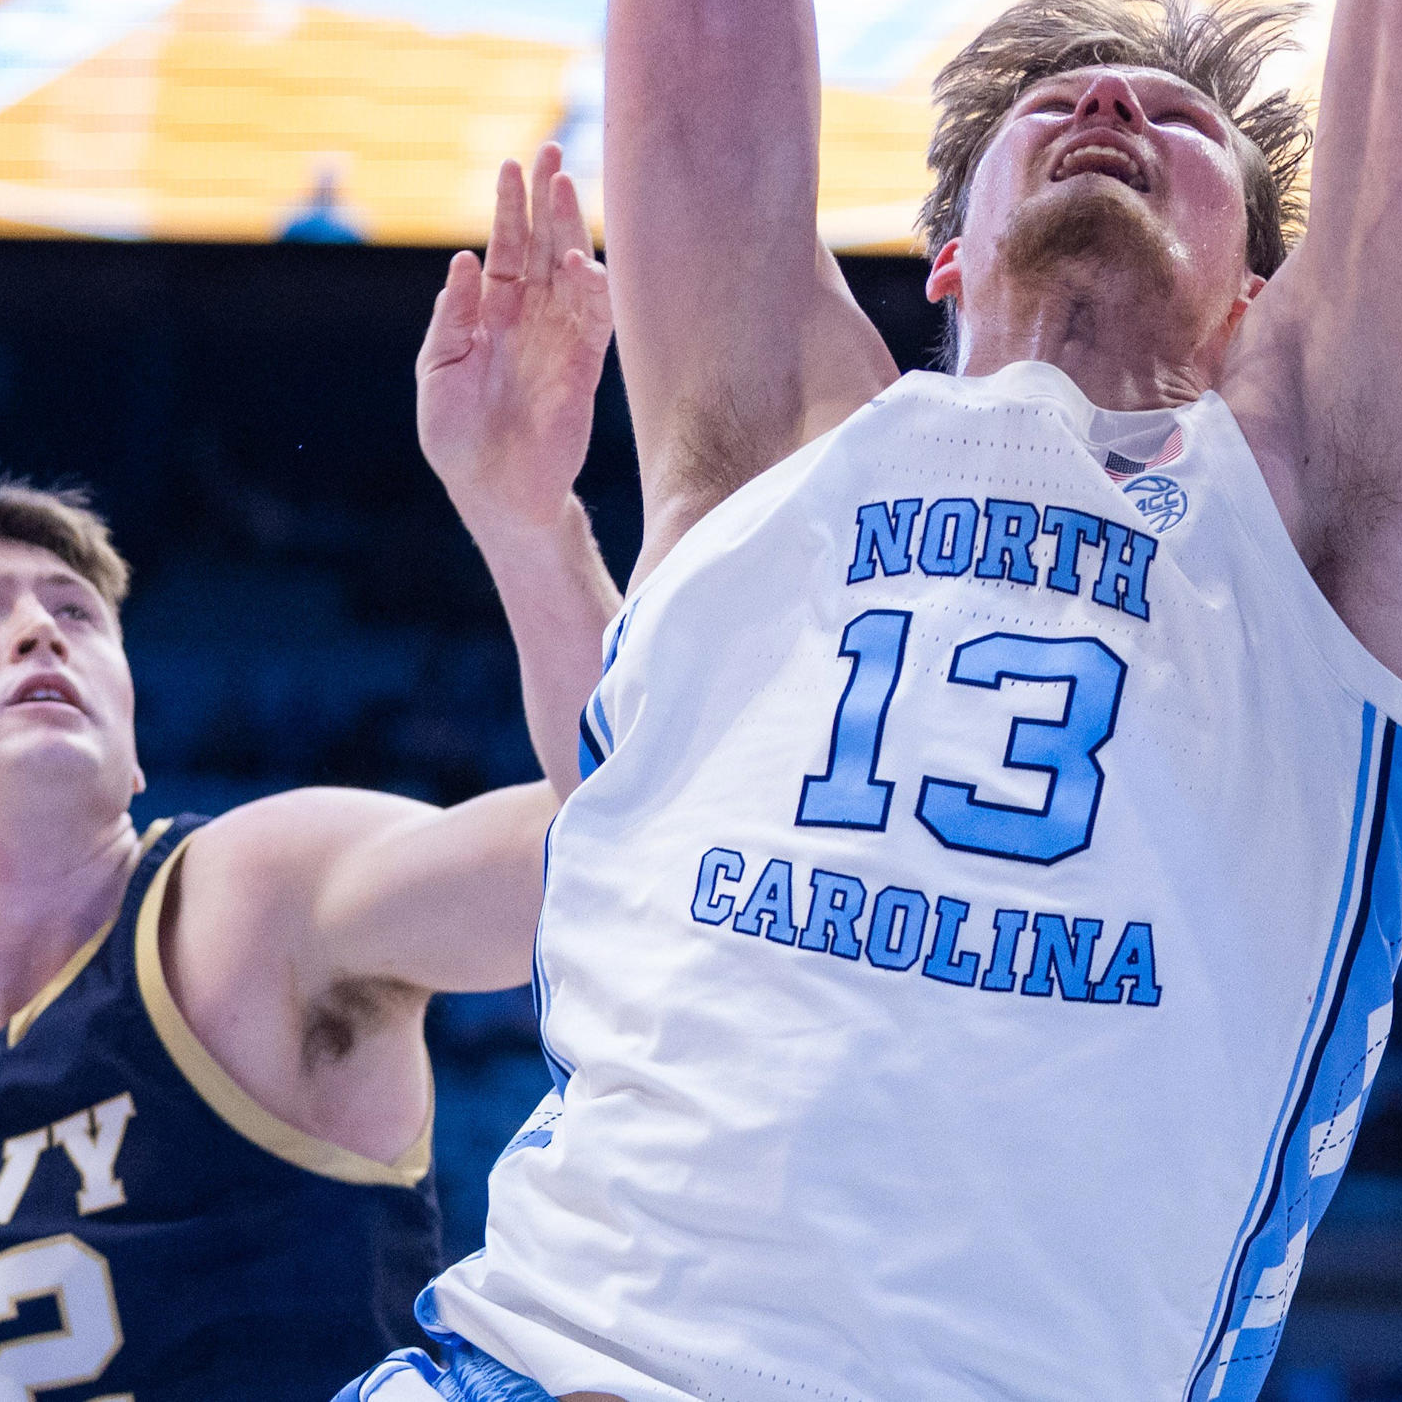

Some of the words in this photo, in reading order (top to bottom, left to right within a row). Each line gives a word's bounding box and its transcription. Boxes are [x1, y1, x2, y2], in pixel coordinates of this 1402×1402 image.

[846, 497, 1159, 623] NORTH
[794, 608, 1129, 867] 13
[690, 847, 1163, 1007] CAROLINA
